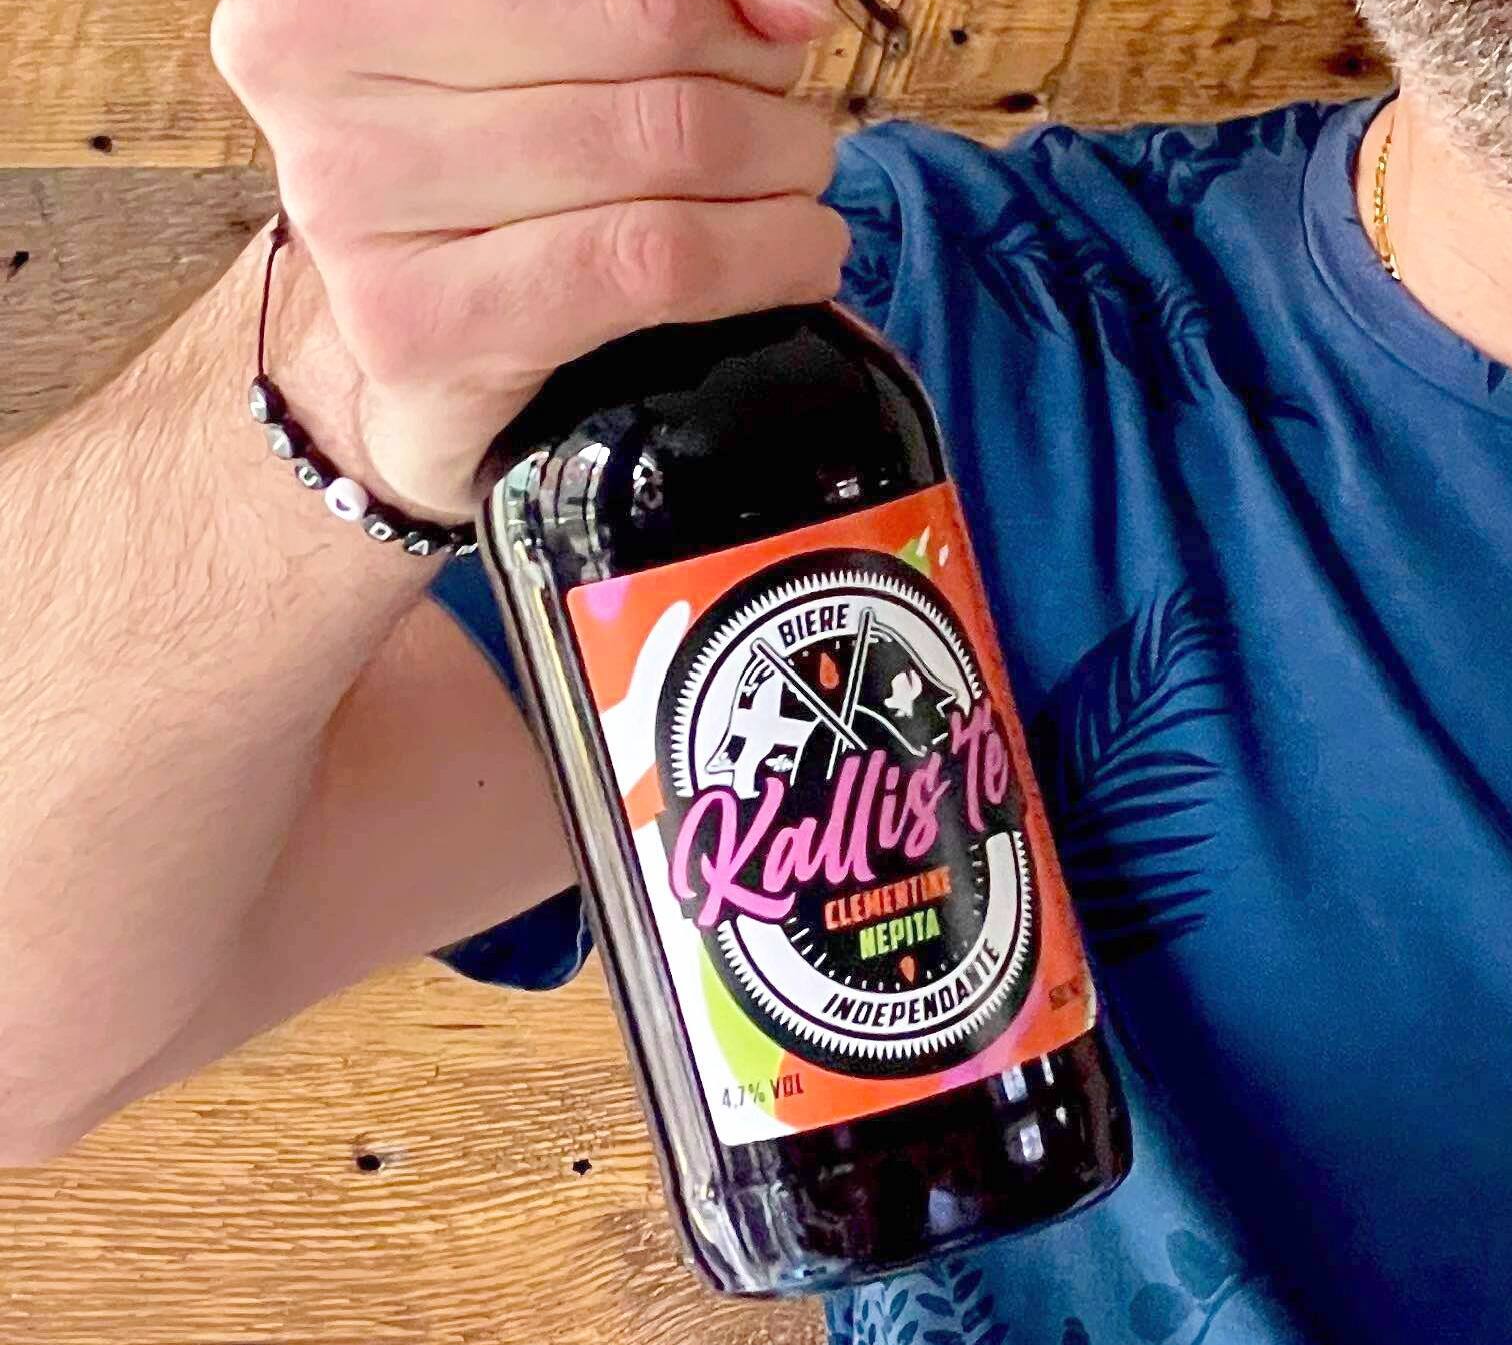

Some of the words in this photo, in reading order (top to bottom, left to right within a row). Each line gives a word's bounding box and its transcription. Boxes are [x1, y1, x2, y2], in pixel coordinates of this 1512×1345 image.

[778, 603, 850, 649] BIERE
[824, 865, 952, 931] CLEMENTINE
[859, 907, 941, 960] NEPITA
[822, 938, 1001, 1027] INDEPENDANTE
